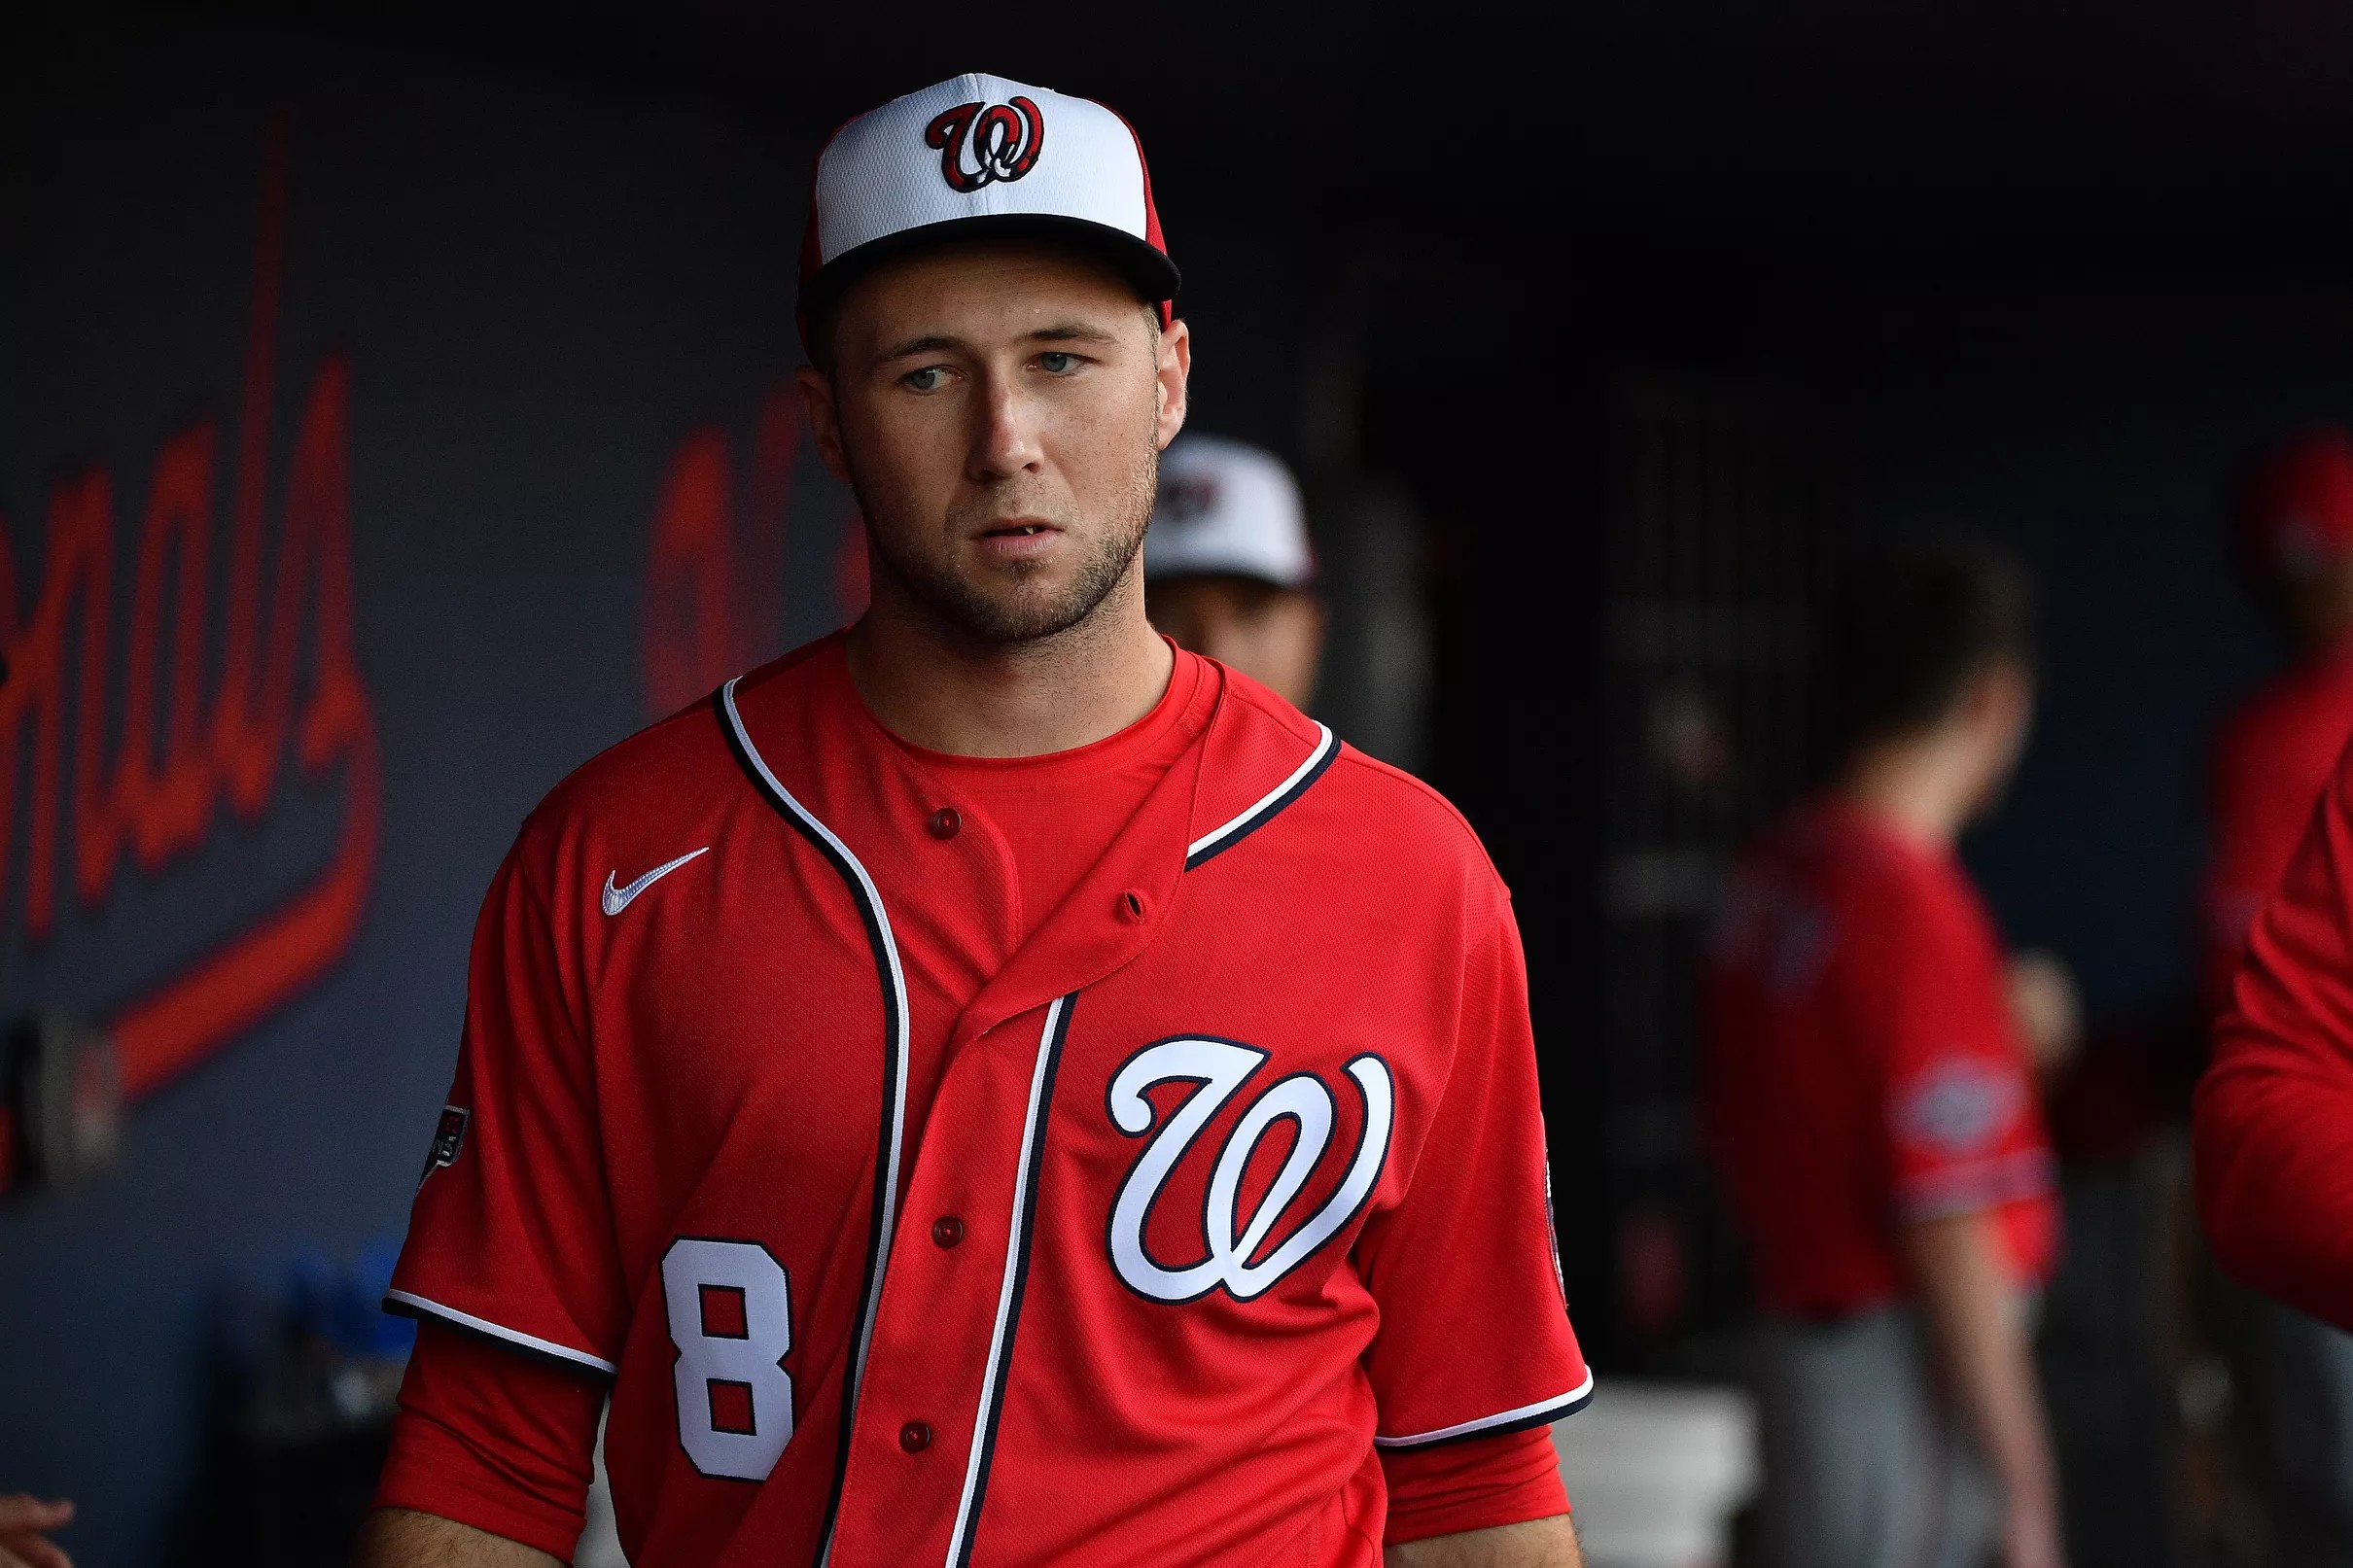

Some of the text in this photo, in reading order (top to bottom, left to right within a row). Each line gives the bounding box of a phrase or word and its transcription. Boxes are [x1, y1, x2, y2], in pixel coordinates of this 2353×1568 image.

[925, 95, 1045, 193] W
[0, 105, 381, 948] nals
[1106, 1033, 1395, 1306] W
[660, 1236, 793, 1481] 8
